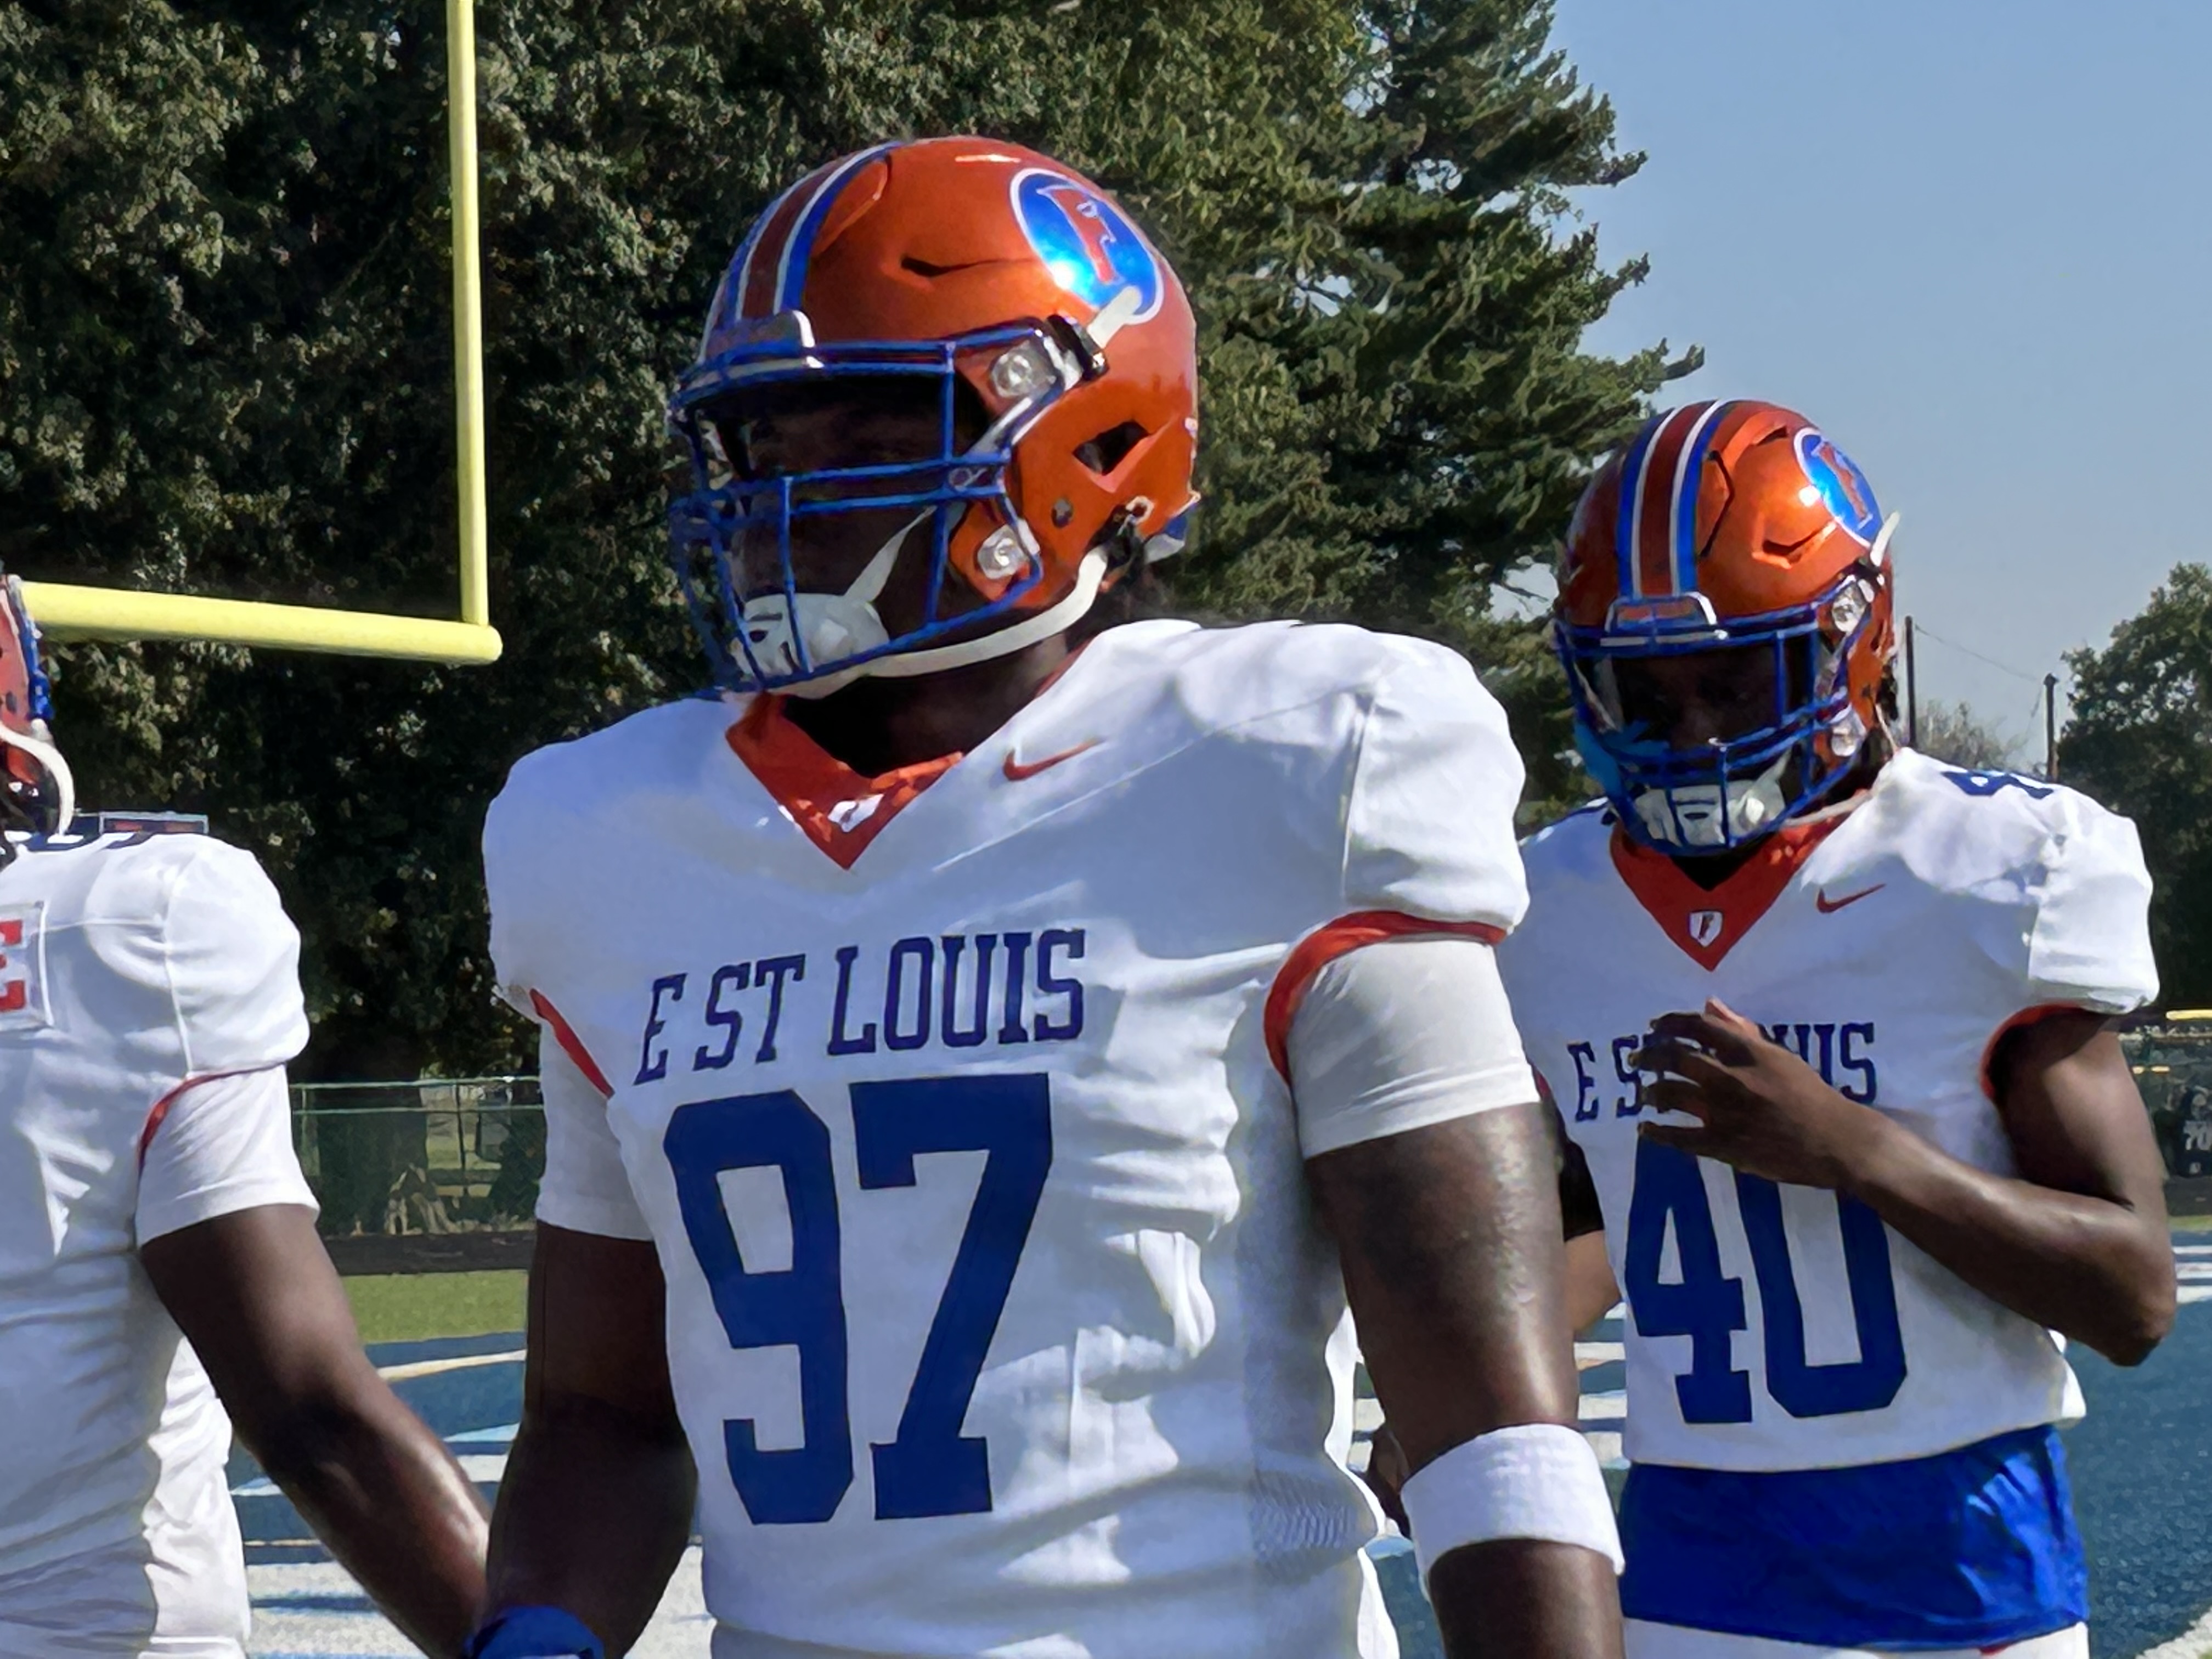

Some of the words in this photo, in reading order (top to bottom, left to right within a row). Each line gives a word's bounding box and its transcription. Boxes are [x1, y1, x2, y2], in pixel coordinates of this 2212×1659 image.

[634, 973, 687, 1085] E
[692, 953, 806, 1072] ST
[827, 929, 1086, 1056] LOUIS
[1567, 1041, 1599, 1122] E
[663, 1073, 1053, 1525] 97
[1624, 1133, 1908, 1424] 40
